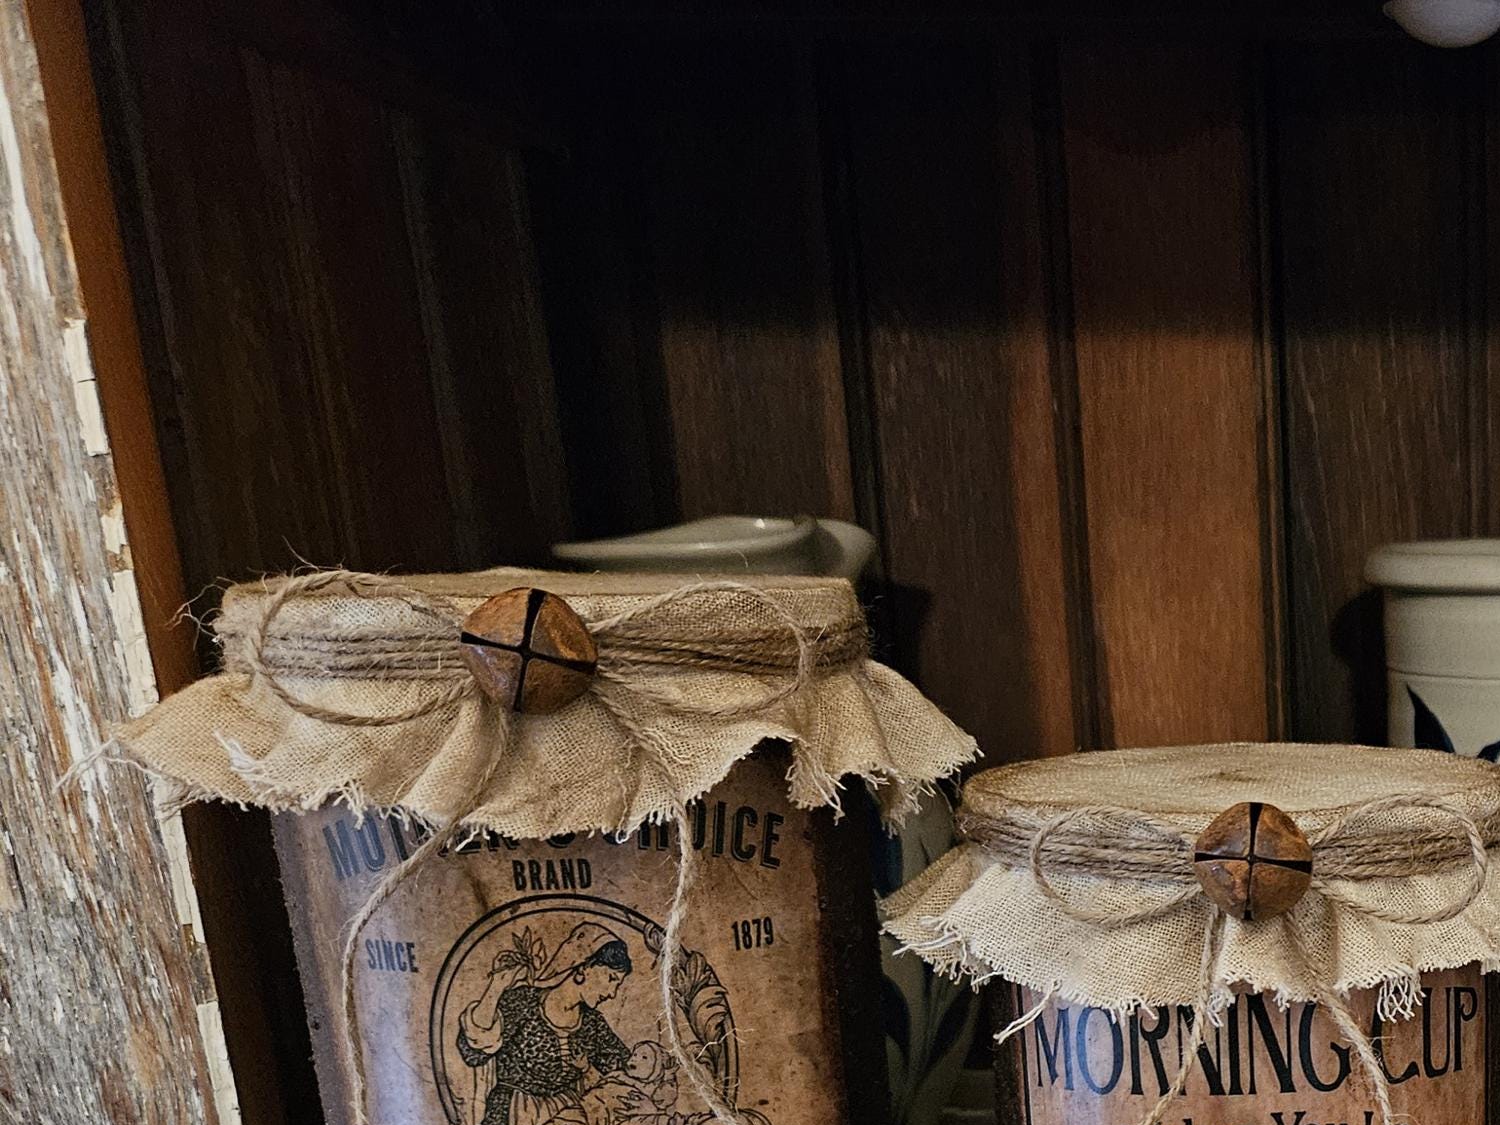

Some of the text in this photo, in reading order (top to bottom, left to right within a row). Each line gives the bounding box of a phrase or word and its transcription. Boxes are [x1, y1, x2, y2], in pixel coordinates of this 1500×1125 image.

[602, 798, 785, 870] HOICE
[512, 858, 592, 892] BRAND
[366, 916, 775, 973] SINCE 1879
[1034, 986, 1478, 1097] MORNING CUP
